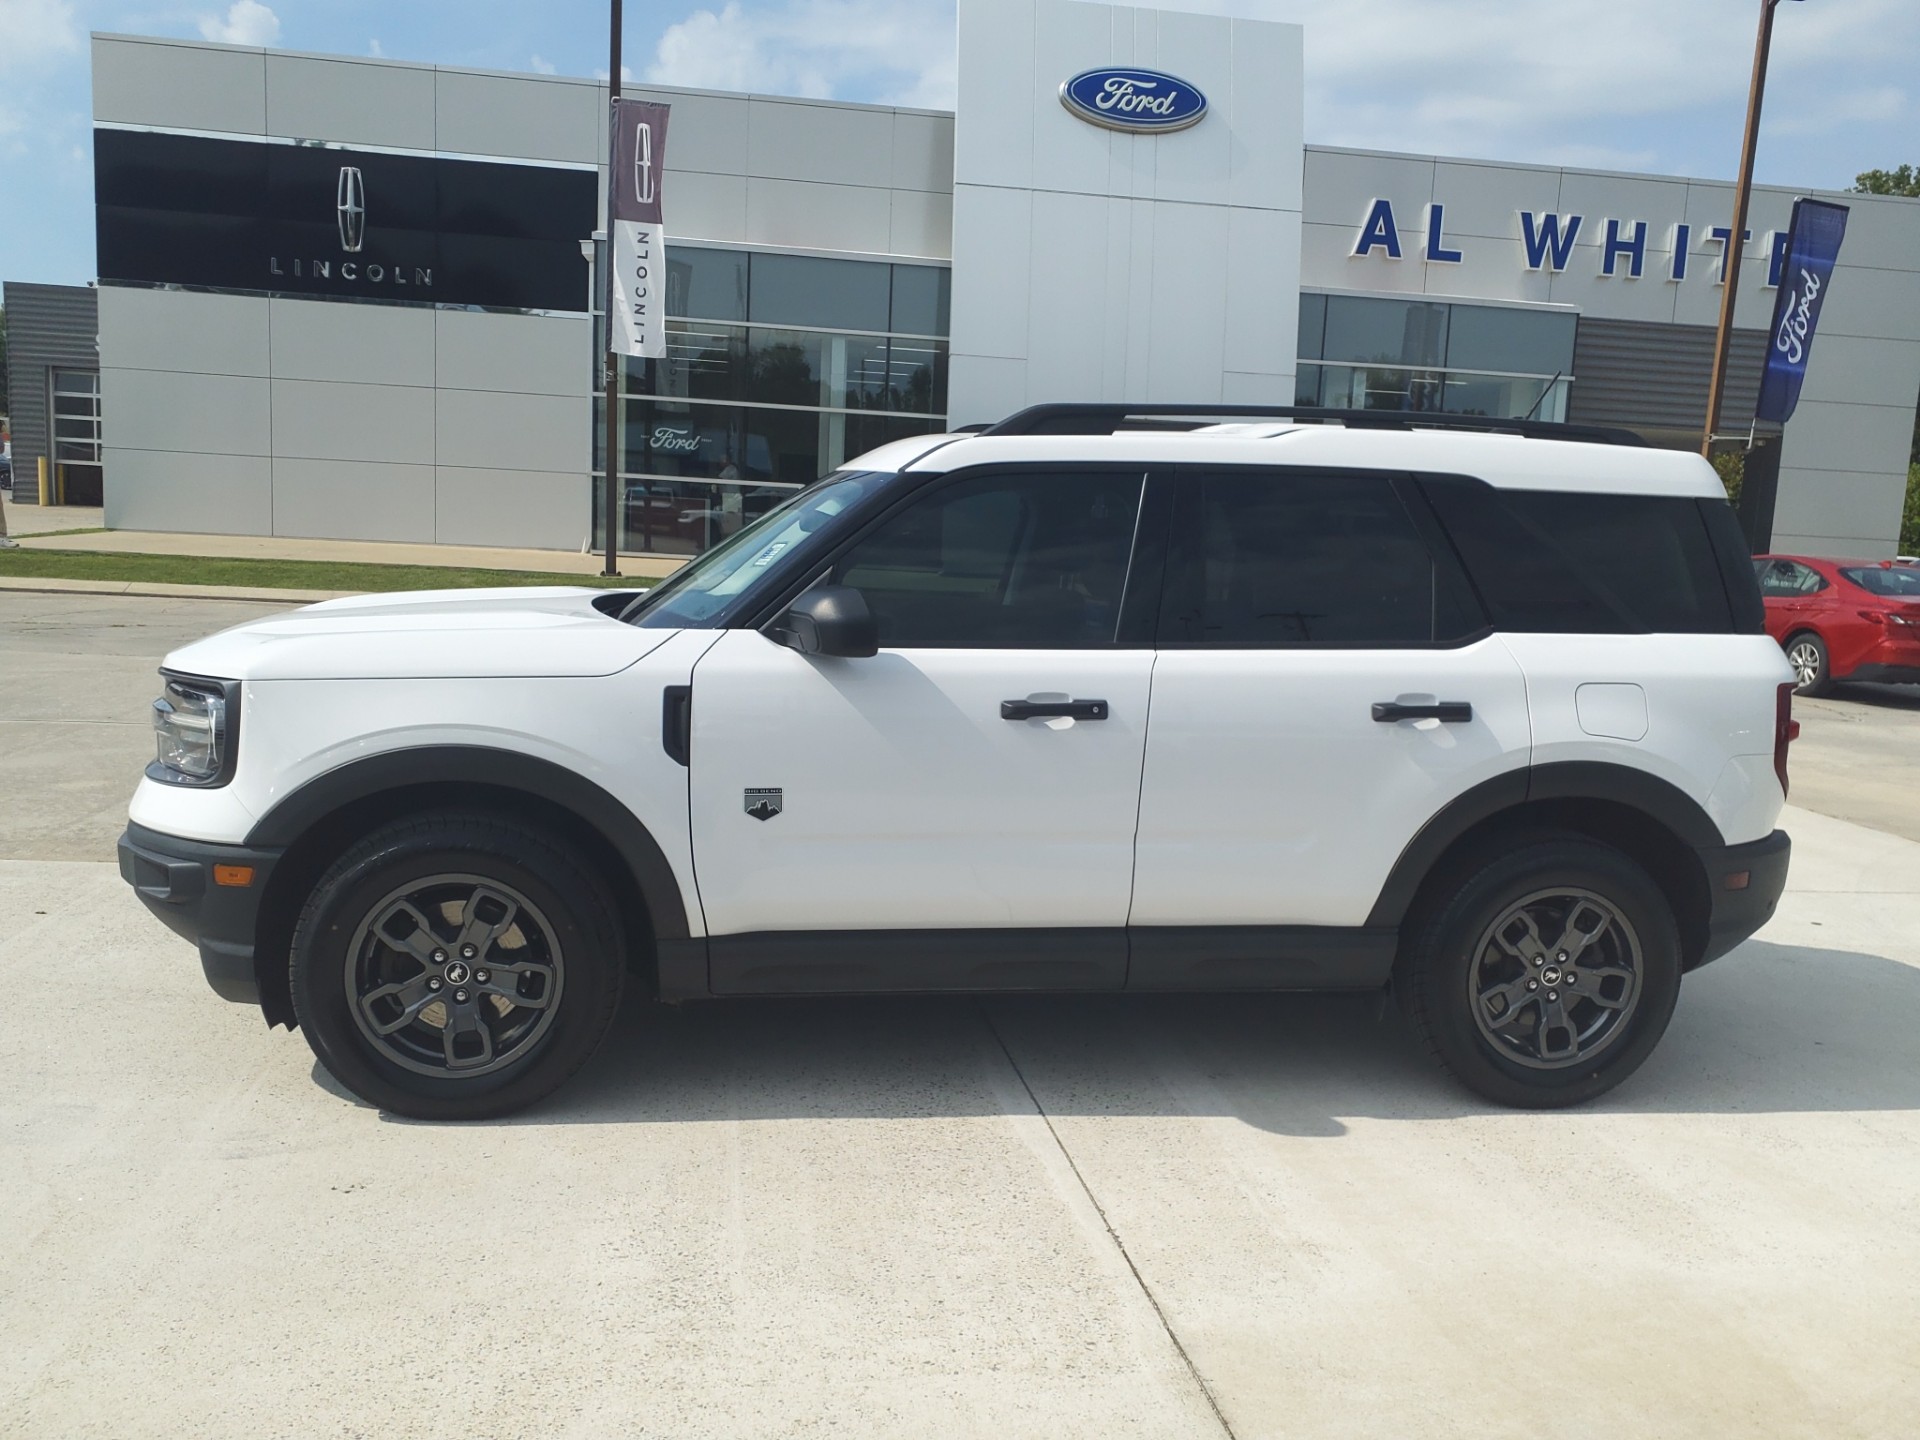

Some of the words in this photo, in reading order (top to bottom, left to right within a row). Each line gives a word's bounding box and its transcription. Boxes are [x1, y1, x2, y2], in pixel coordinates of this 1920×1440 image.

[1095, 77, 1178, 115] Ford
[1350, 198, 1464, 264] AL
[270, 256, 433, 286] LINCOLN
[633, 231, 650, 344] LINCOLN
[1776, 267, 1821, 364] Ford
[649, 427, 701, 451] Ford
